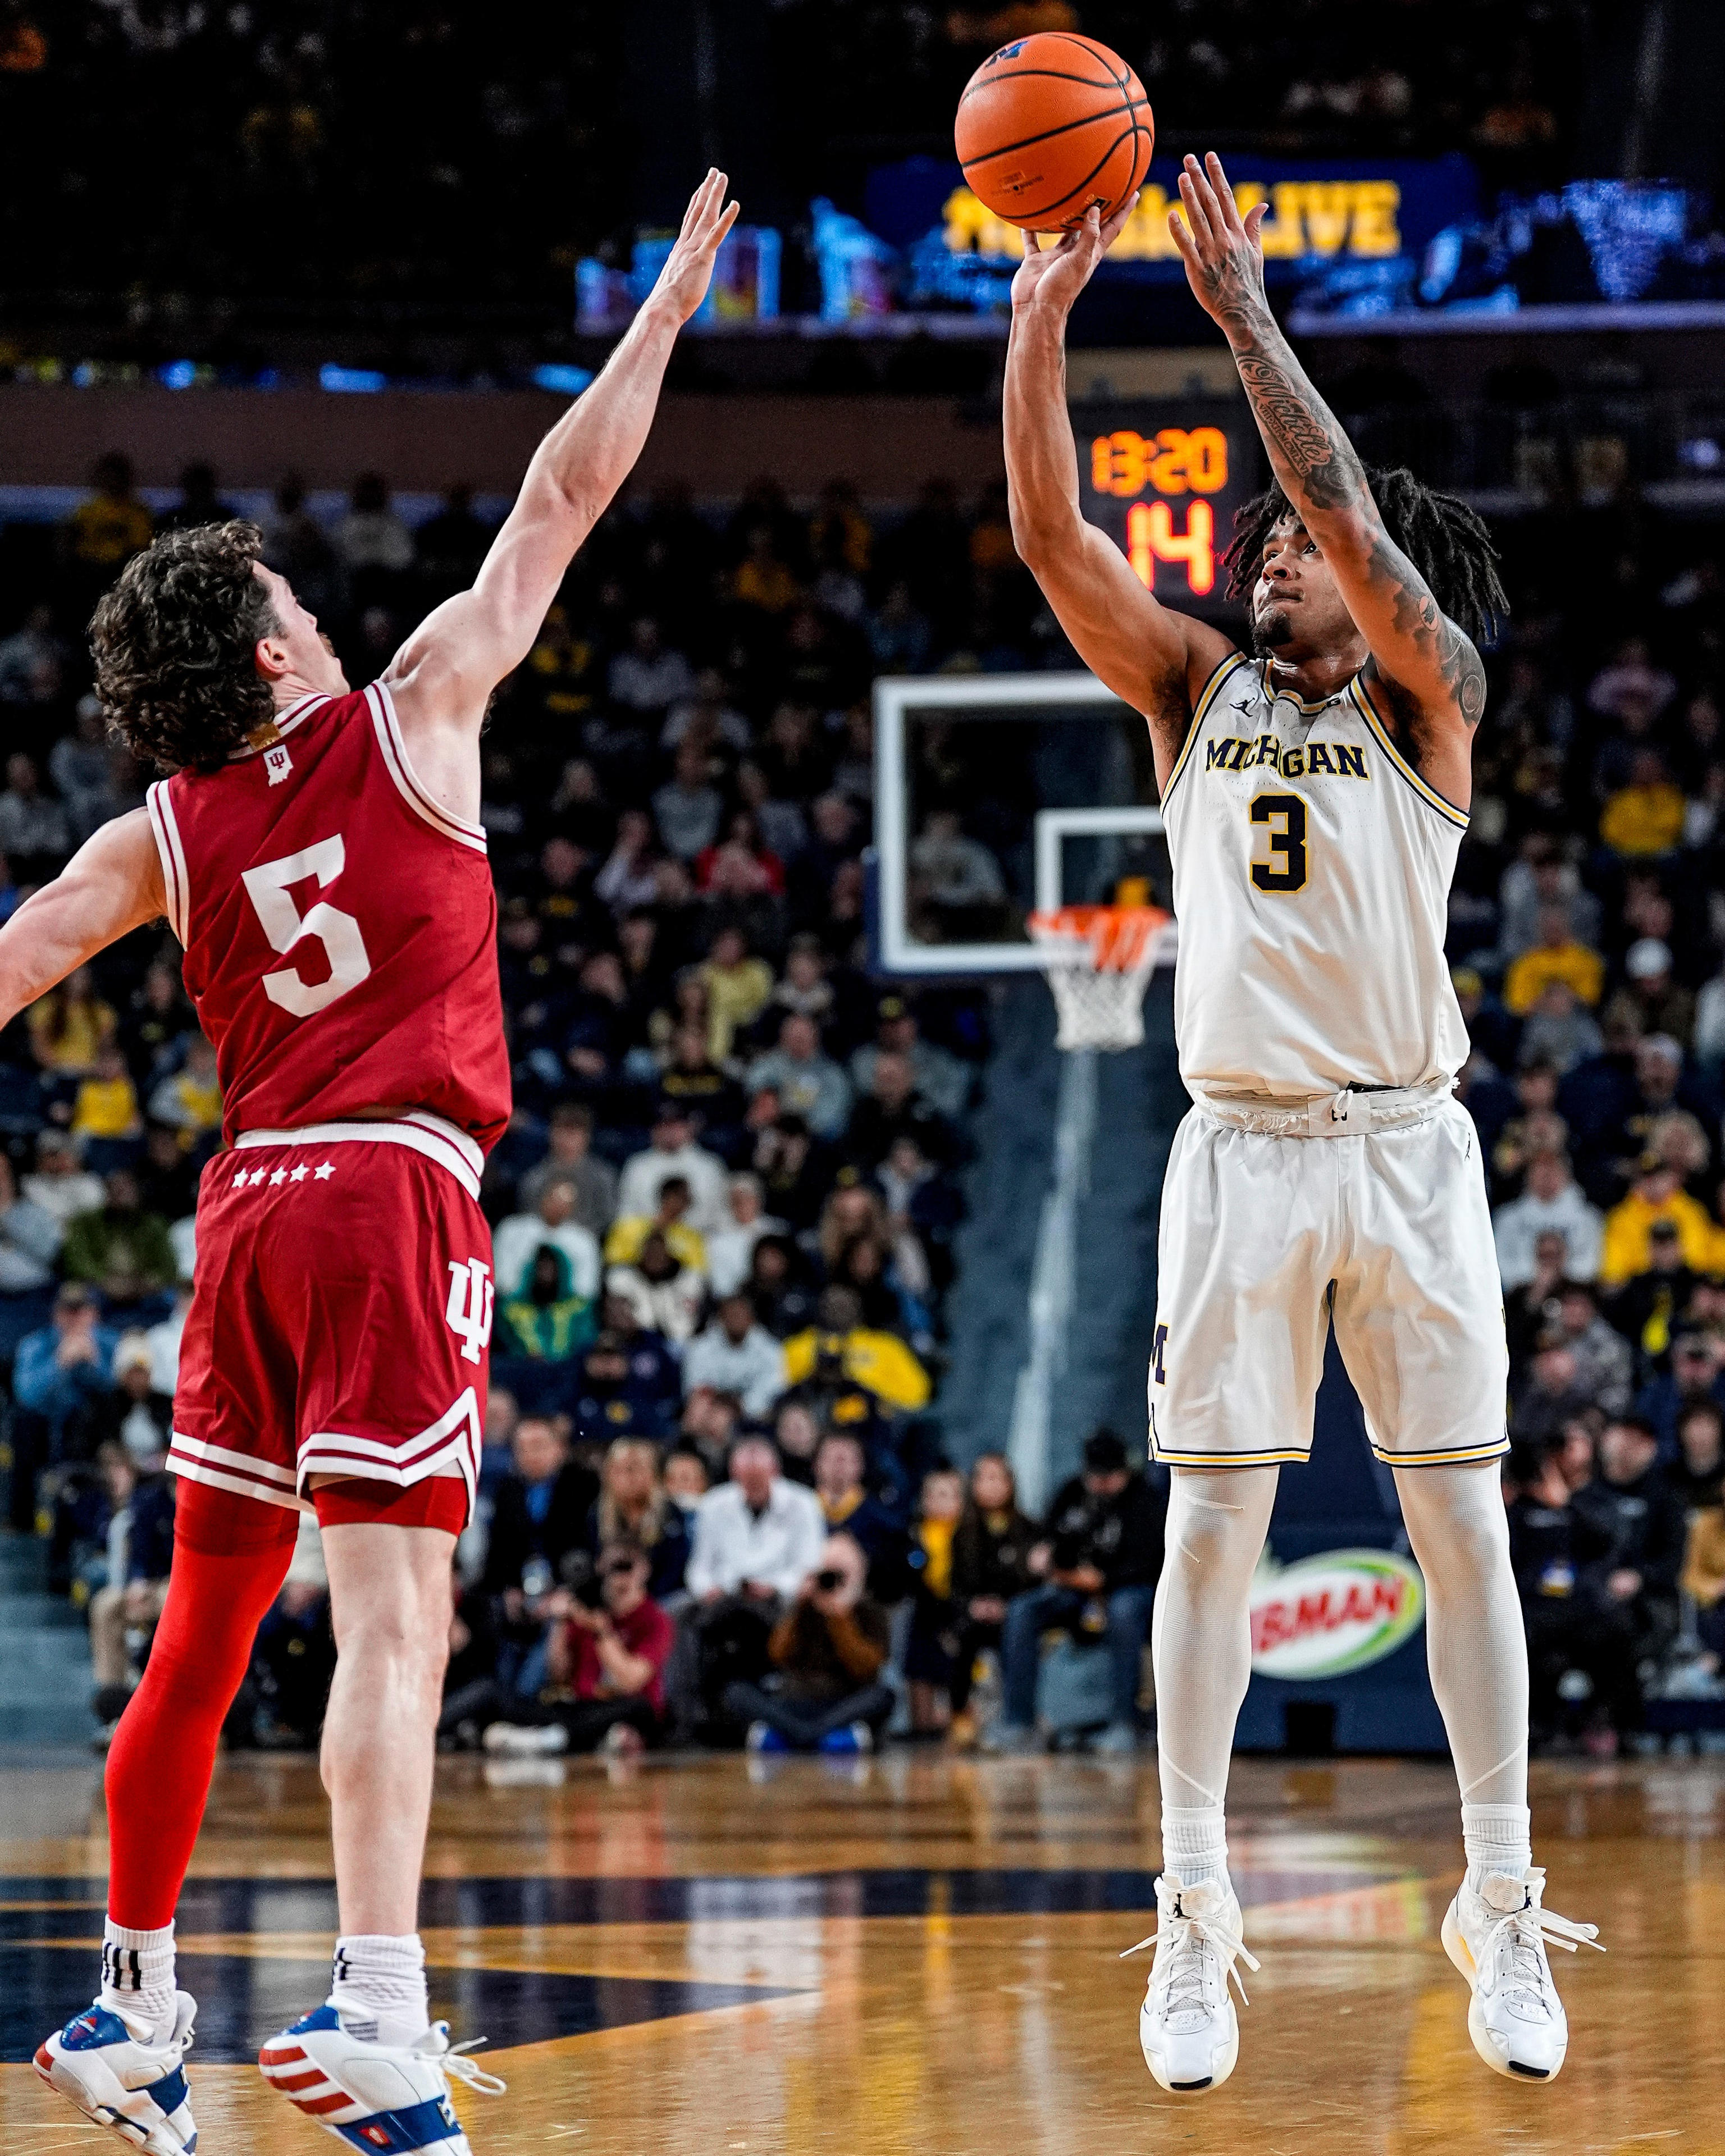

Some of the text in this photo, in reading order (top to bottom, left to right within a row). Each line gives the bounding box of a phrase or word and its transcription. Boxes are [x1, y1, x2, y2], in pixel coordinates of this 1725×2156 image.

[1092, 427, 1229, 497] 13:20
[1128, 499, 1215, 596] 14
[1205, 733, 1371, 781] MICHGAN
[1249, 792, 1309, 894] 3
[241, 833, 371, 1017] 5
